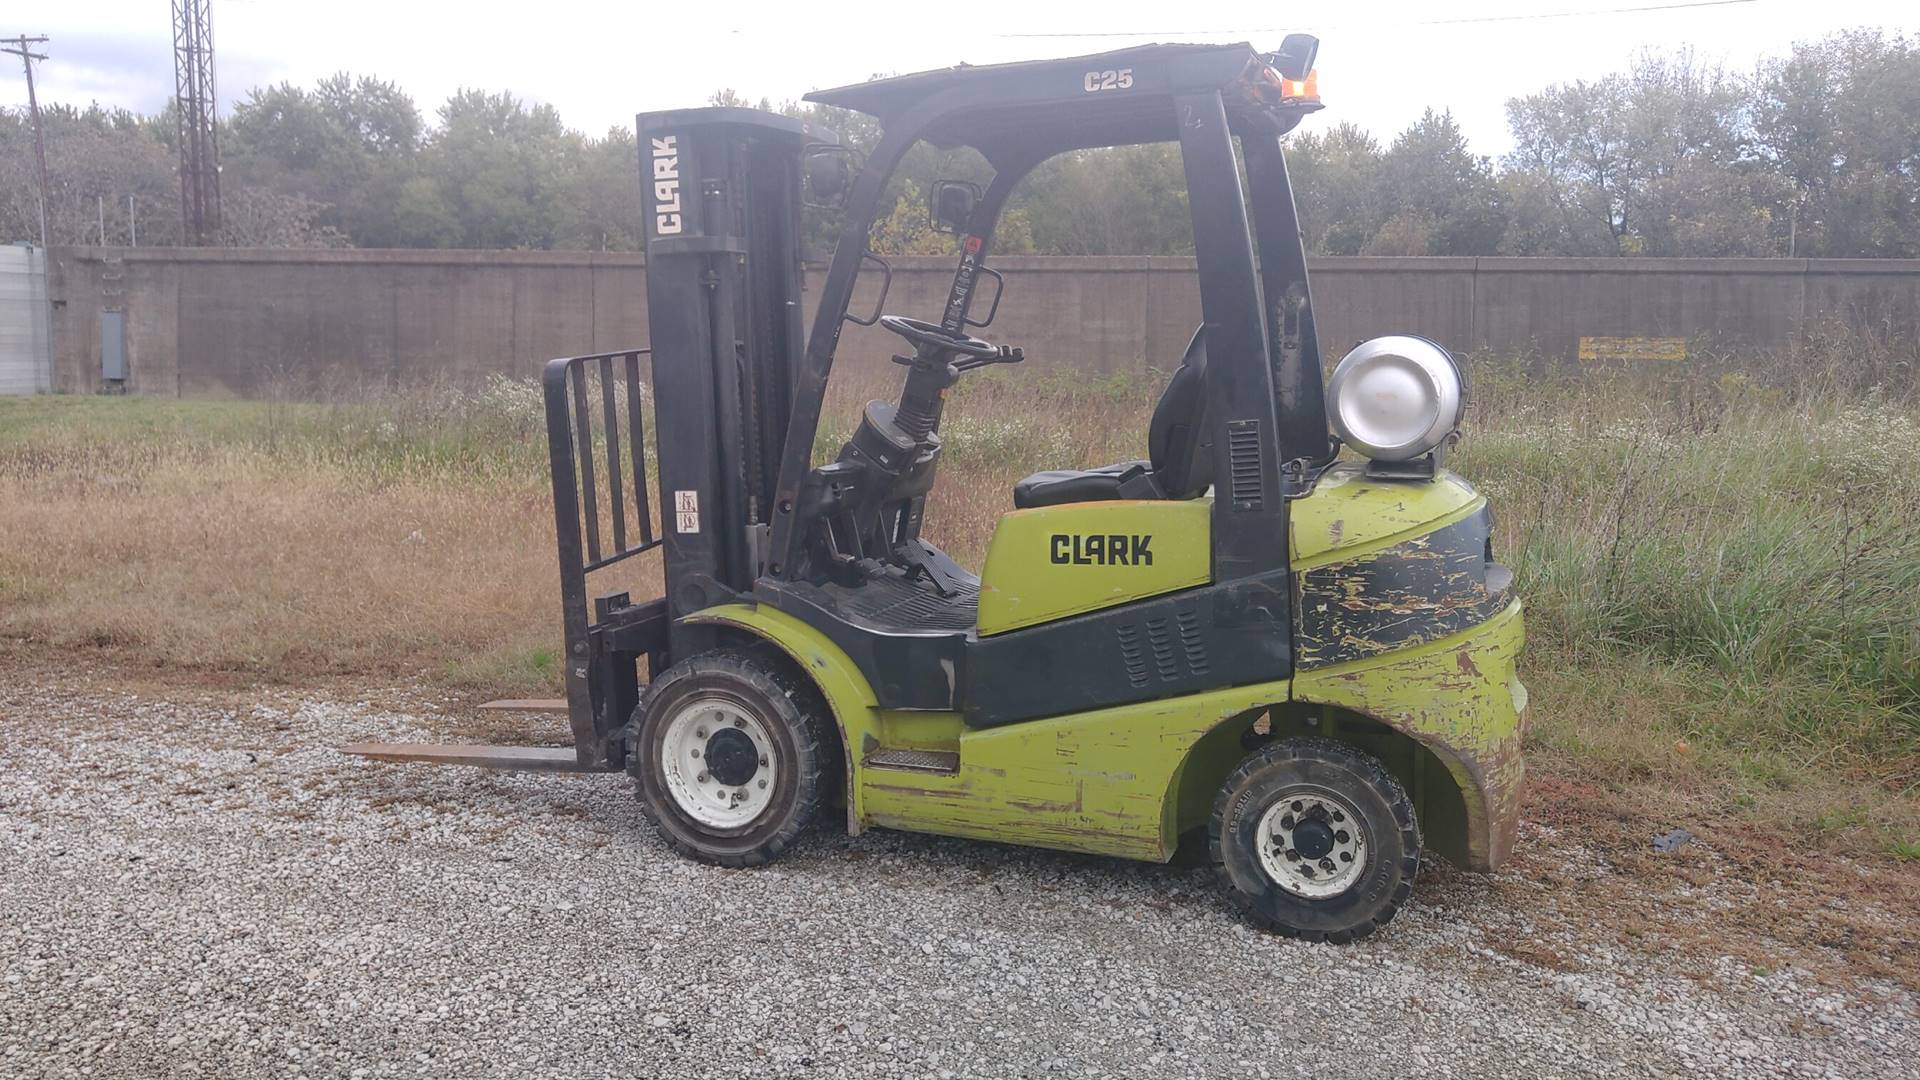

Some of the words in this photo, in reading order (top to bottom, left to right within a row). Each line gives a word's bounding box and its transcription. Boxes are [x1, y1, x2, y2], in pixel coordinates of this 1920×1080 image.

[1084, 68, 1133, 92] C25
[652, 135, 681, 234] CLARK
[1051, 534, 1152, 565] CLARK
